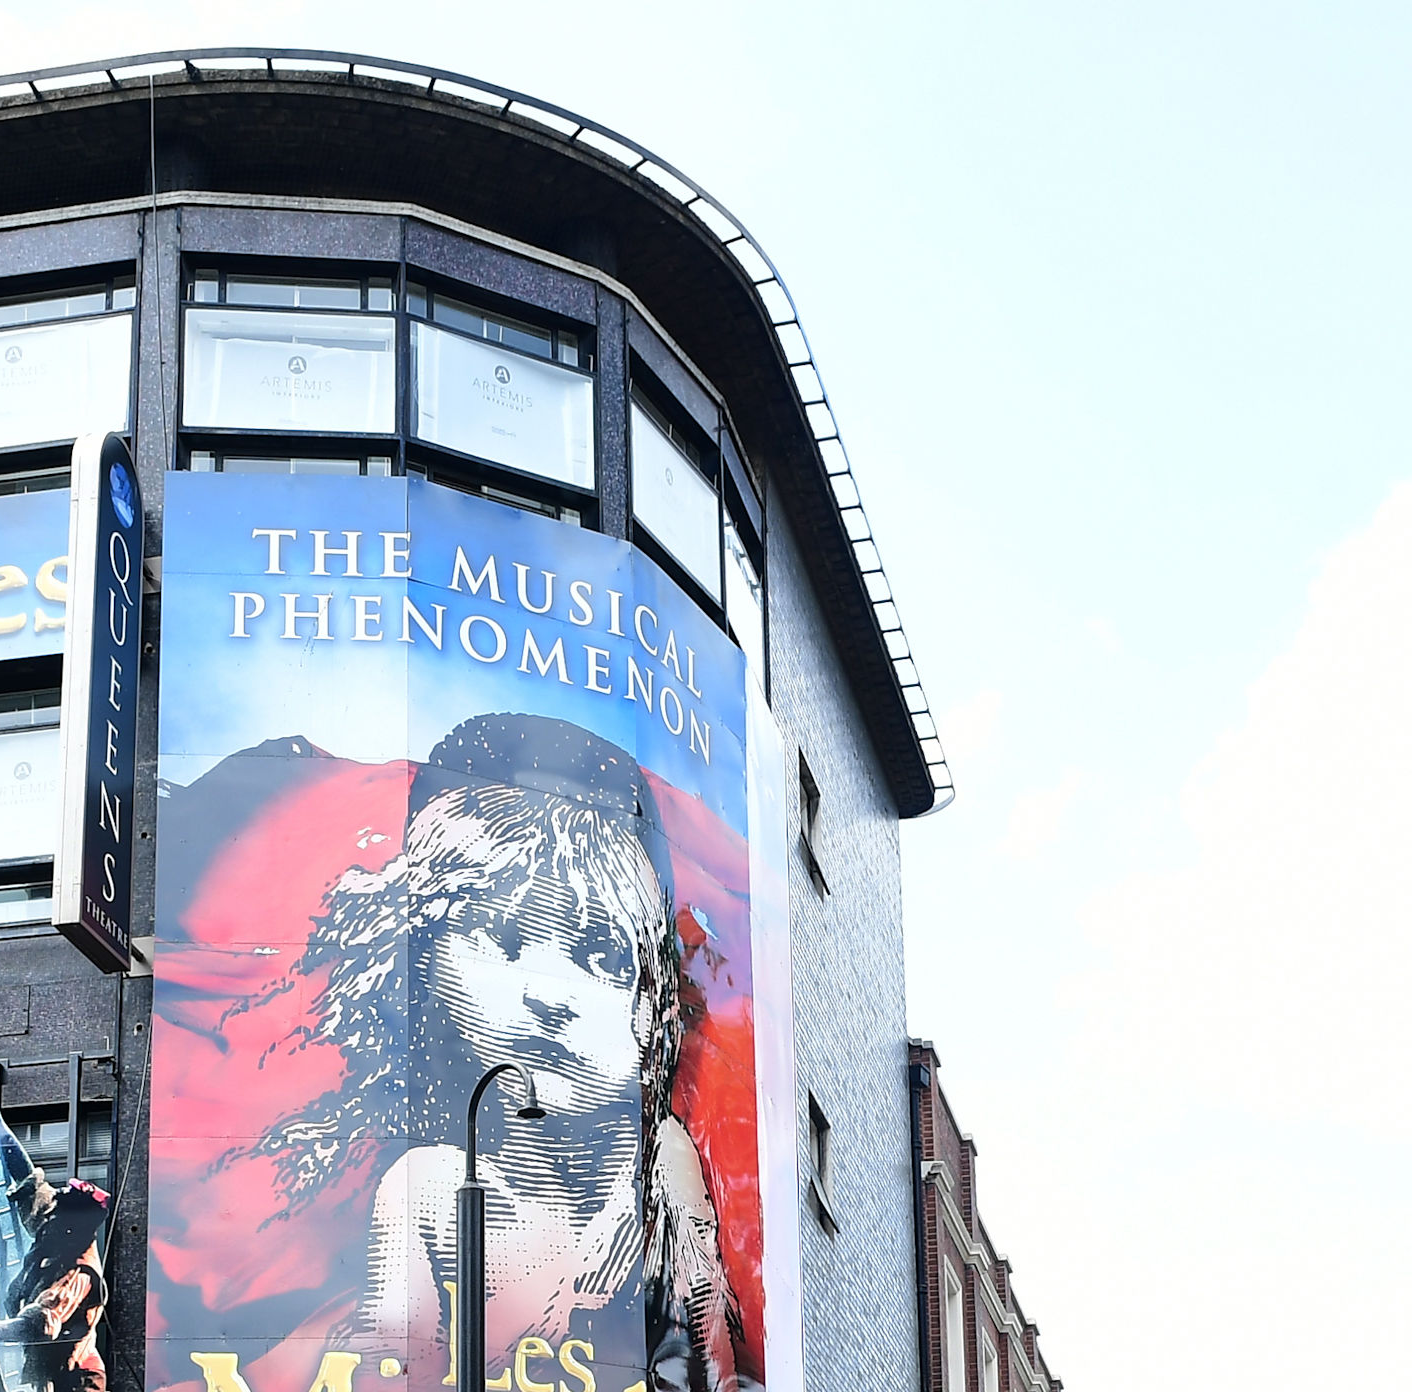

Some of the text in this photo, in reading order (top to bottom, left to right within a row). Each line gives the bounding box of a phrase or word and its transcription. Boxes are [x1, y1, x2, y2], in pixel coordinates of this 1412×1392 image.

[260, 376, 333, 393] ARTEMIS
[471, 377, 533, 408] ARTEMIS
[251, 527, 704, 700] THE MUSICAL
[99, 530, 135, 904] QUEENS
[228, 591, 711, 767] PHENOMENON
[84, 896, 129, 951] THEATRE
